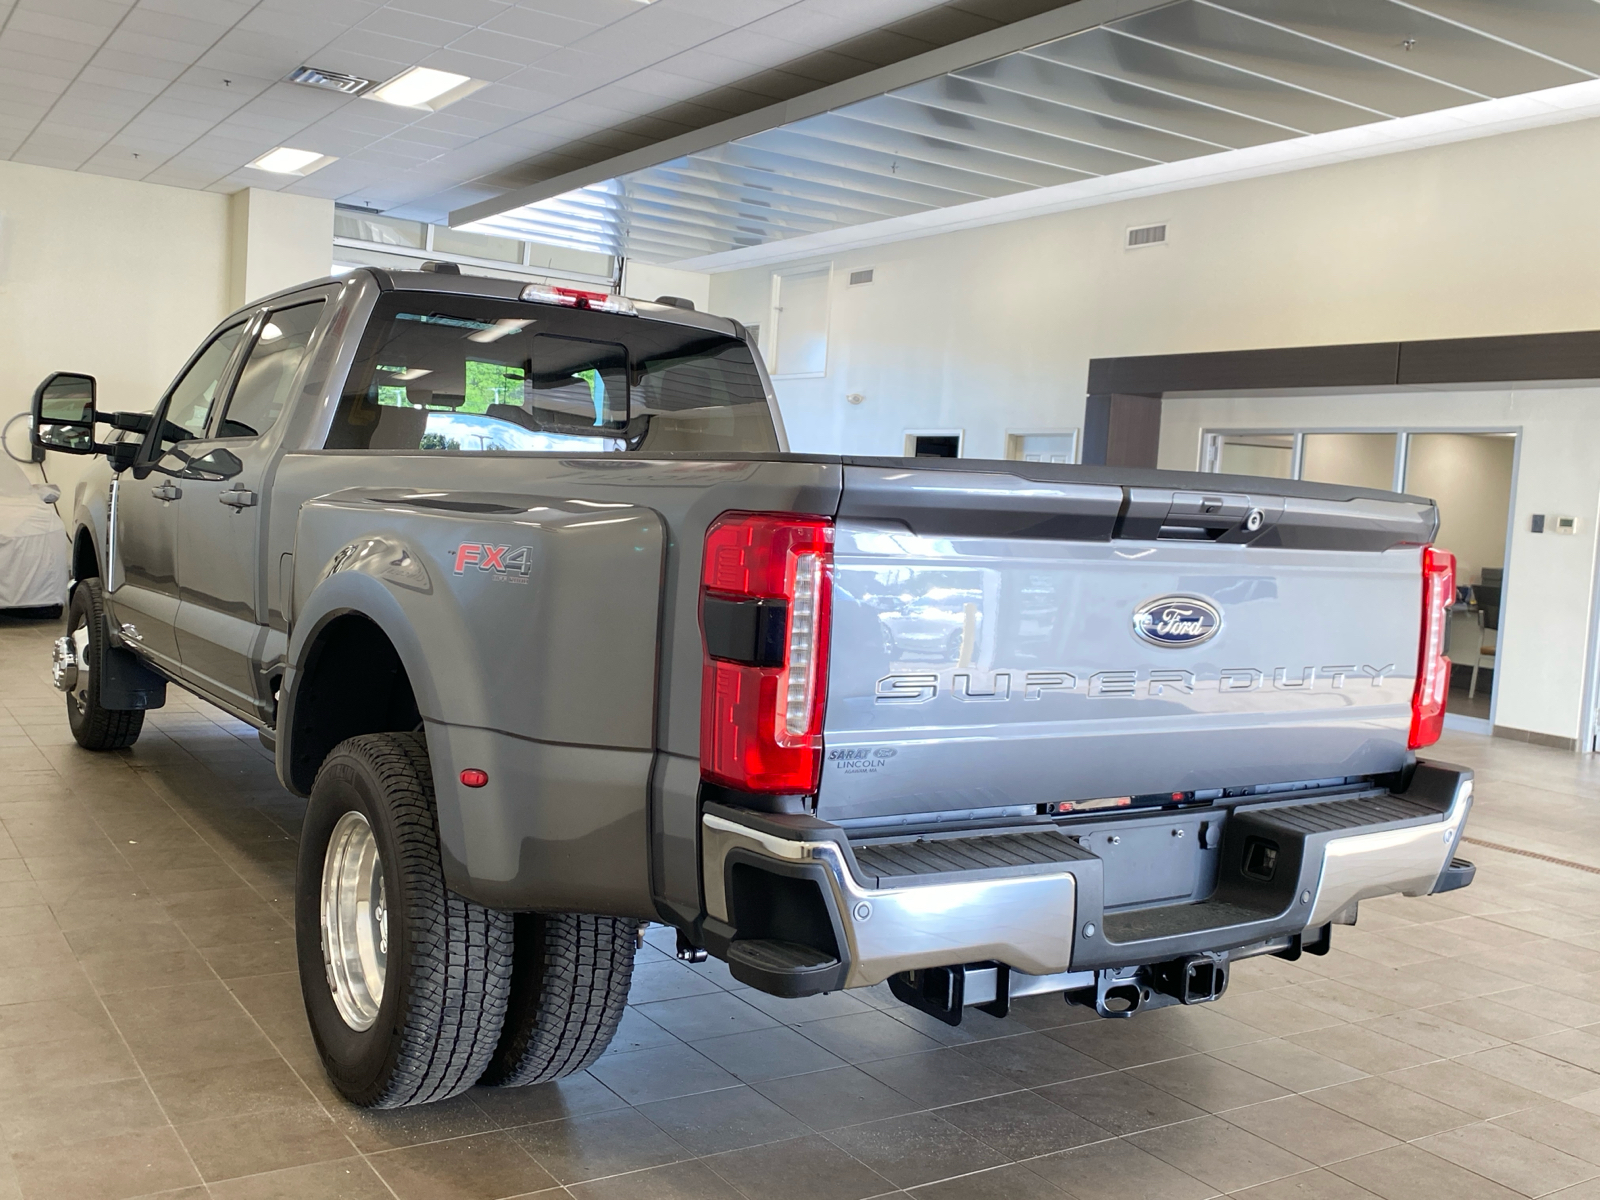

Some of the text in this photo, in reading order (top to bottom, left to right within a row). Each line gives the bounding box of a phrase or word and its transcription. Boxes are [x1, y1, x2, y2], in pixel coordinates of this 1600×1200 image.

[453, 541, 533, 577] FX4
[874, 663, 1396, 705] SUPER DUTY
[828, 748, 871, 761] SARAT
[837, 760, 885, 769] LINCOLN
